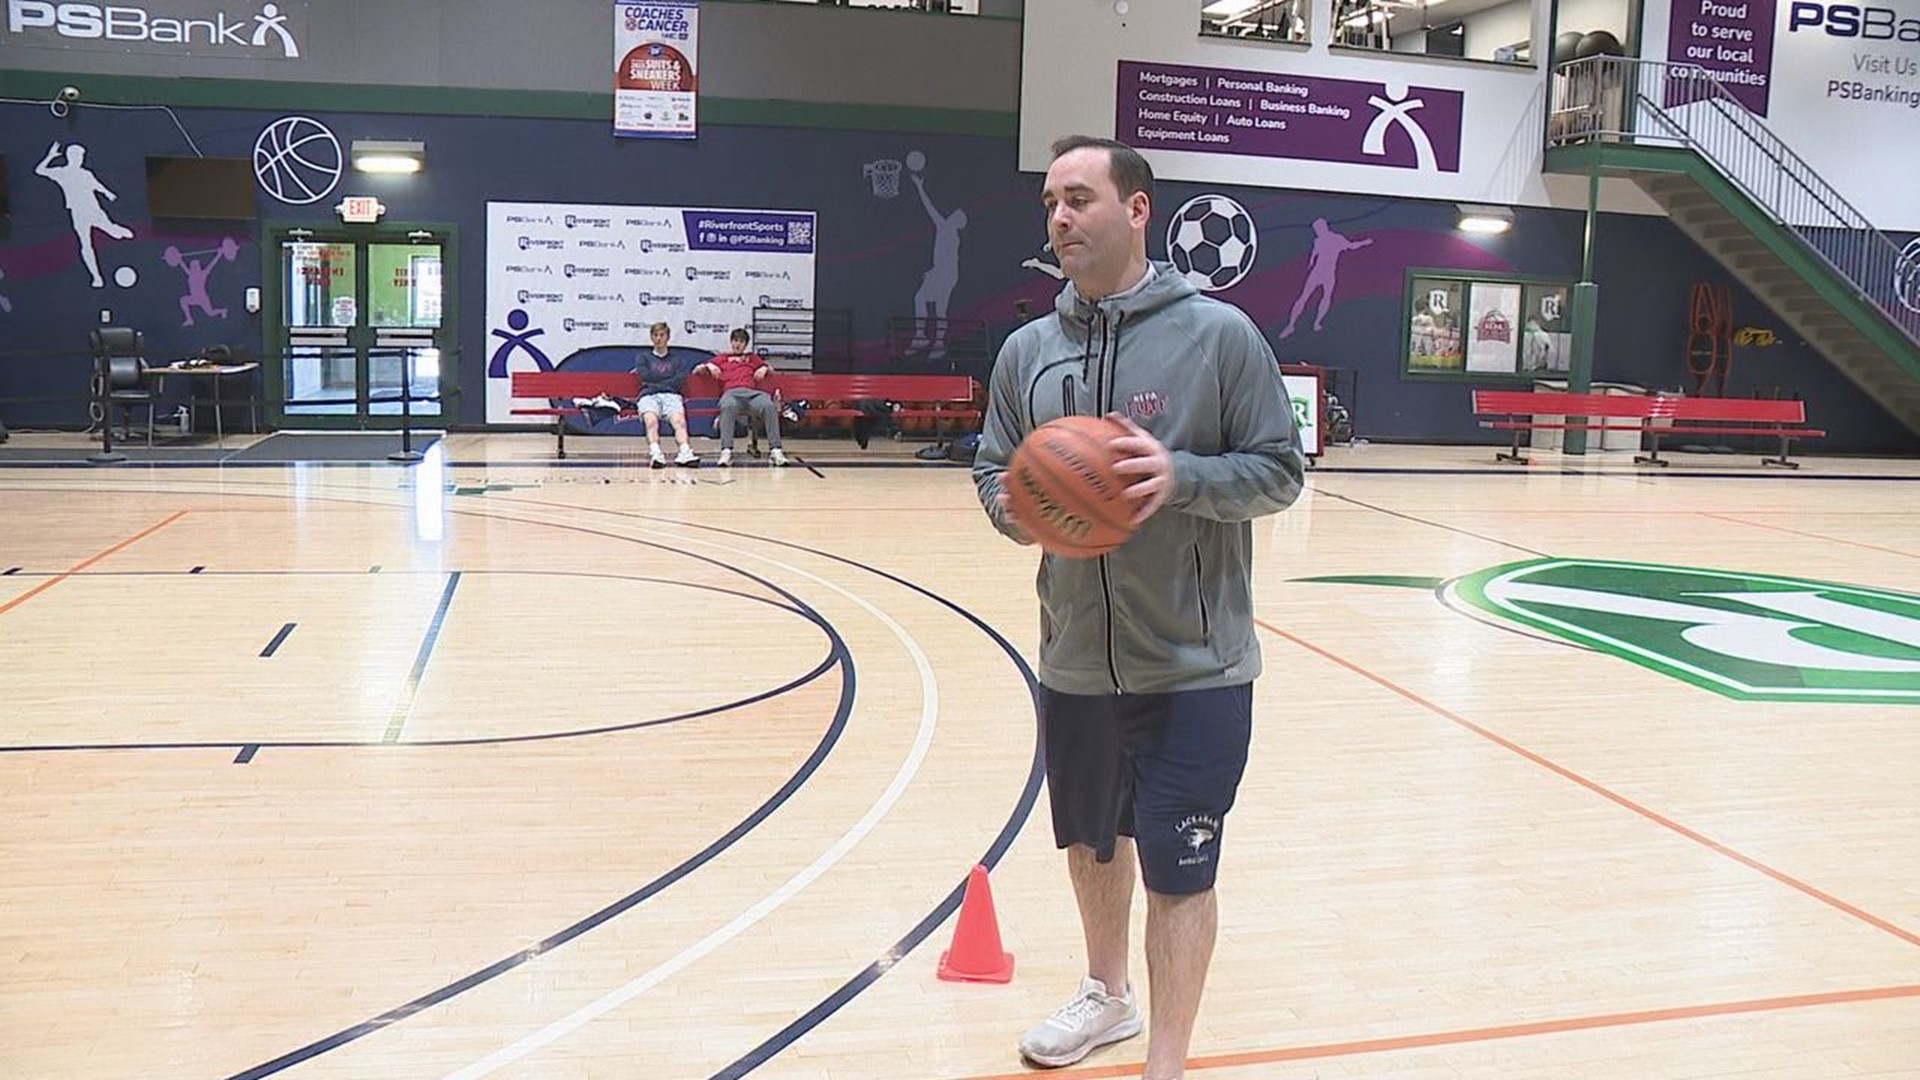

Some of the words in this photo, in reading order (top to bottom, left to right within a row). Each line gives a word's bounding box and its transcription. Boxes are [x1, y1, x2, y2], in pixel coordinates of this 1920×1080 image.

[625, 7, 684, 20] COACHES
[1701, 0, 1747, 18] Proud
[8, 0, 248, 46] PSBank
[638, 19, 689, 32] CANCER
[1691, 22, 1708, 36] to
[1711, 26, 1753, 41] serve
[1687, 46, 1714, 59] our
[1717, 45, 1753, 63] local
[1853, 54, 1890, 73] Visit
[1895, 57, 1917, 75] Us
[1140, 72, 1198, 87] Mortgages
[1218, 78, 1263, 92] Personal
[1265, 81, 1309, 97] Banking
[1827, 80, 1920, 109] PSBanking
[1139, 90, 1208, 105] Construction
[1210, 96, 1241, 107] Loans
[1260, 100, 1306, 113] Business
[1308, 103, 1350, 119] Banking
[1138, 108, 1171, 120] Home
[1173, 111, 1208, 125] Equity
[1226, 115, 1253, 127] Auto
[1255, 117, 1287, 130] Loans
[1138, 127, 1196, 141] Equipment
[1198, 131, 1230, 143] Loans
[349, 200, 371, 215] EXIT
[698, 220, 784, 232] #RiverfrontSports
[729, 235, 785, 246] @PSBanking
